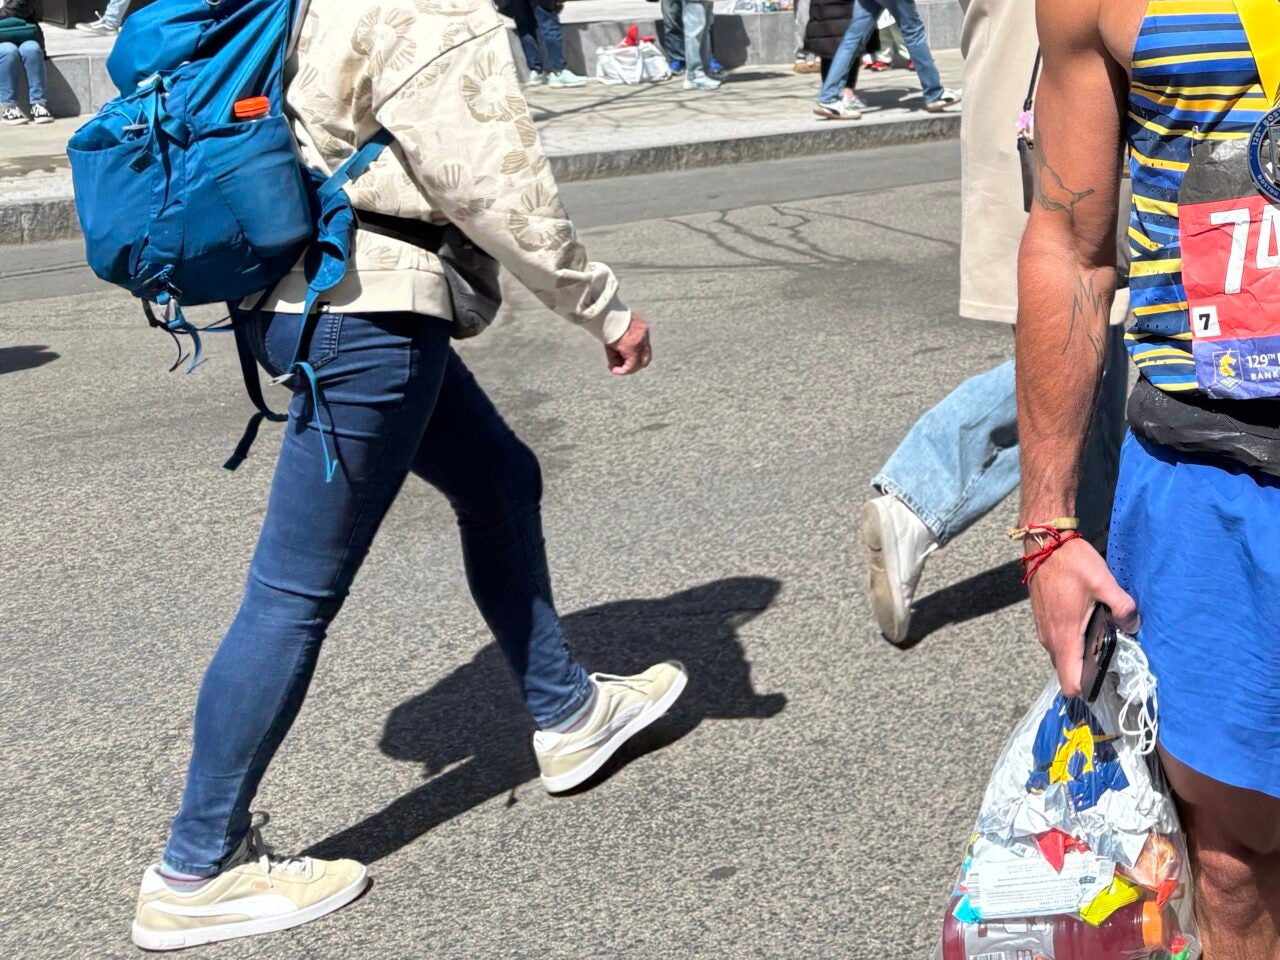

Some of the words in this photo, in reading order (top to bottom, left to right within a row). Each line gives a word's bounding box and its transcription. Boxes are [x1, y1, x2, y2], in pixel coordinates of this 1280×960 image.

[1257, 174, 1280, 197] BOSTON
[1198, 313, 1211, 331] 7
[1250, 370, 1280, 381] BANK
